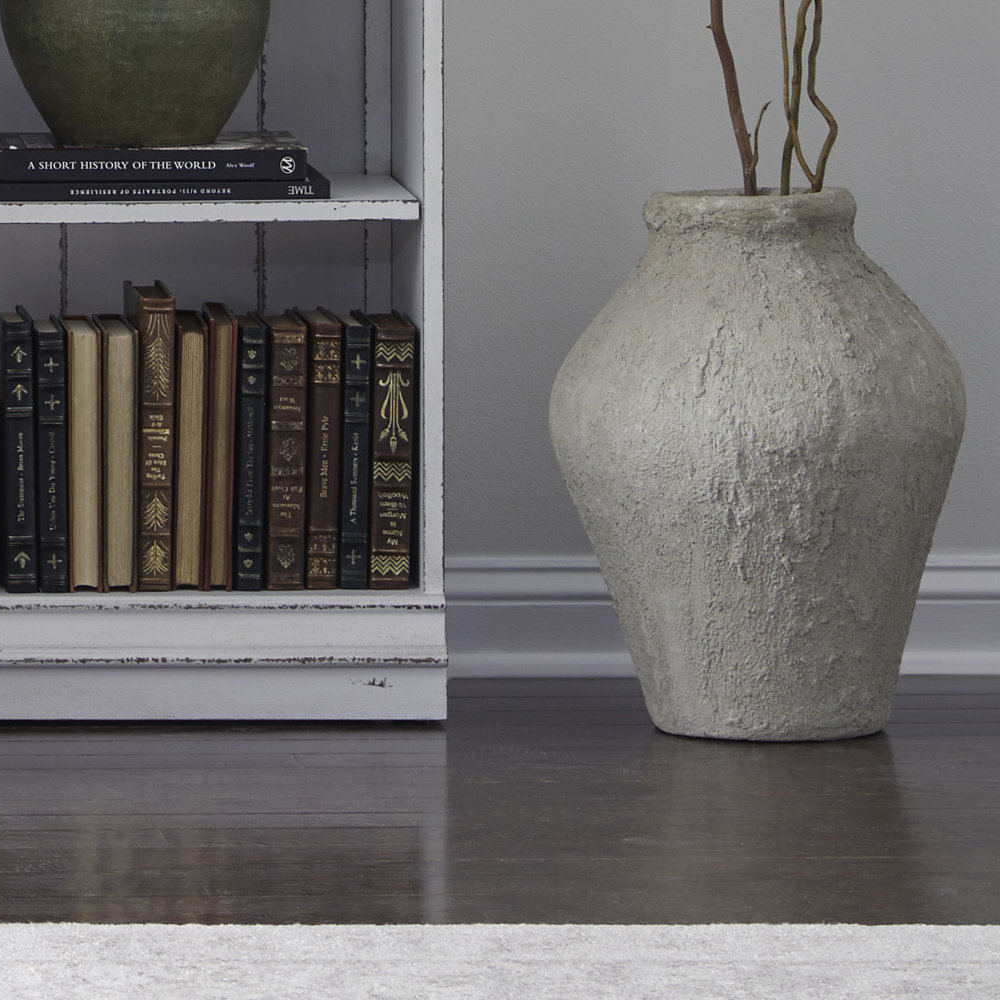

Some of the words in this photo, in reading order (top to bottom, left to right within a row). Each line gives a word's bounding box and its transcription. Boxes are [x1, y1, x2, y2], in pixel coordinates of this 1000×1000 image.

[28, 161, 35, 170] A
[38, 160, 75, 170] SHORT
[80, 160, 129, 170] HISTORY
[132, 160, 148, 170] OF
[150, 160, 172, 170] THE
[174, 160, 216, 170] WORLD
[288, 186, 314, 195] TIME
[320, 460, 328, 476] Men
[349, 486, 357, 515] Thousand
